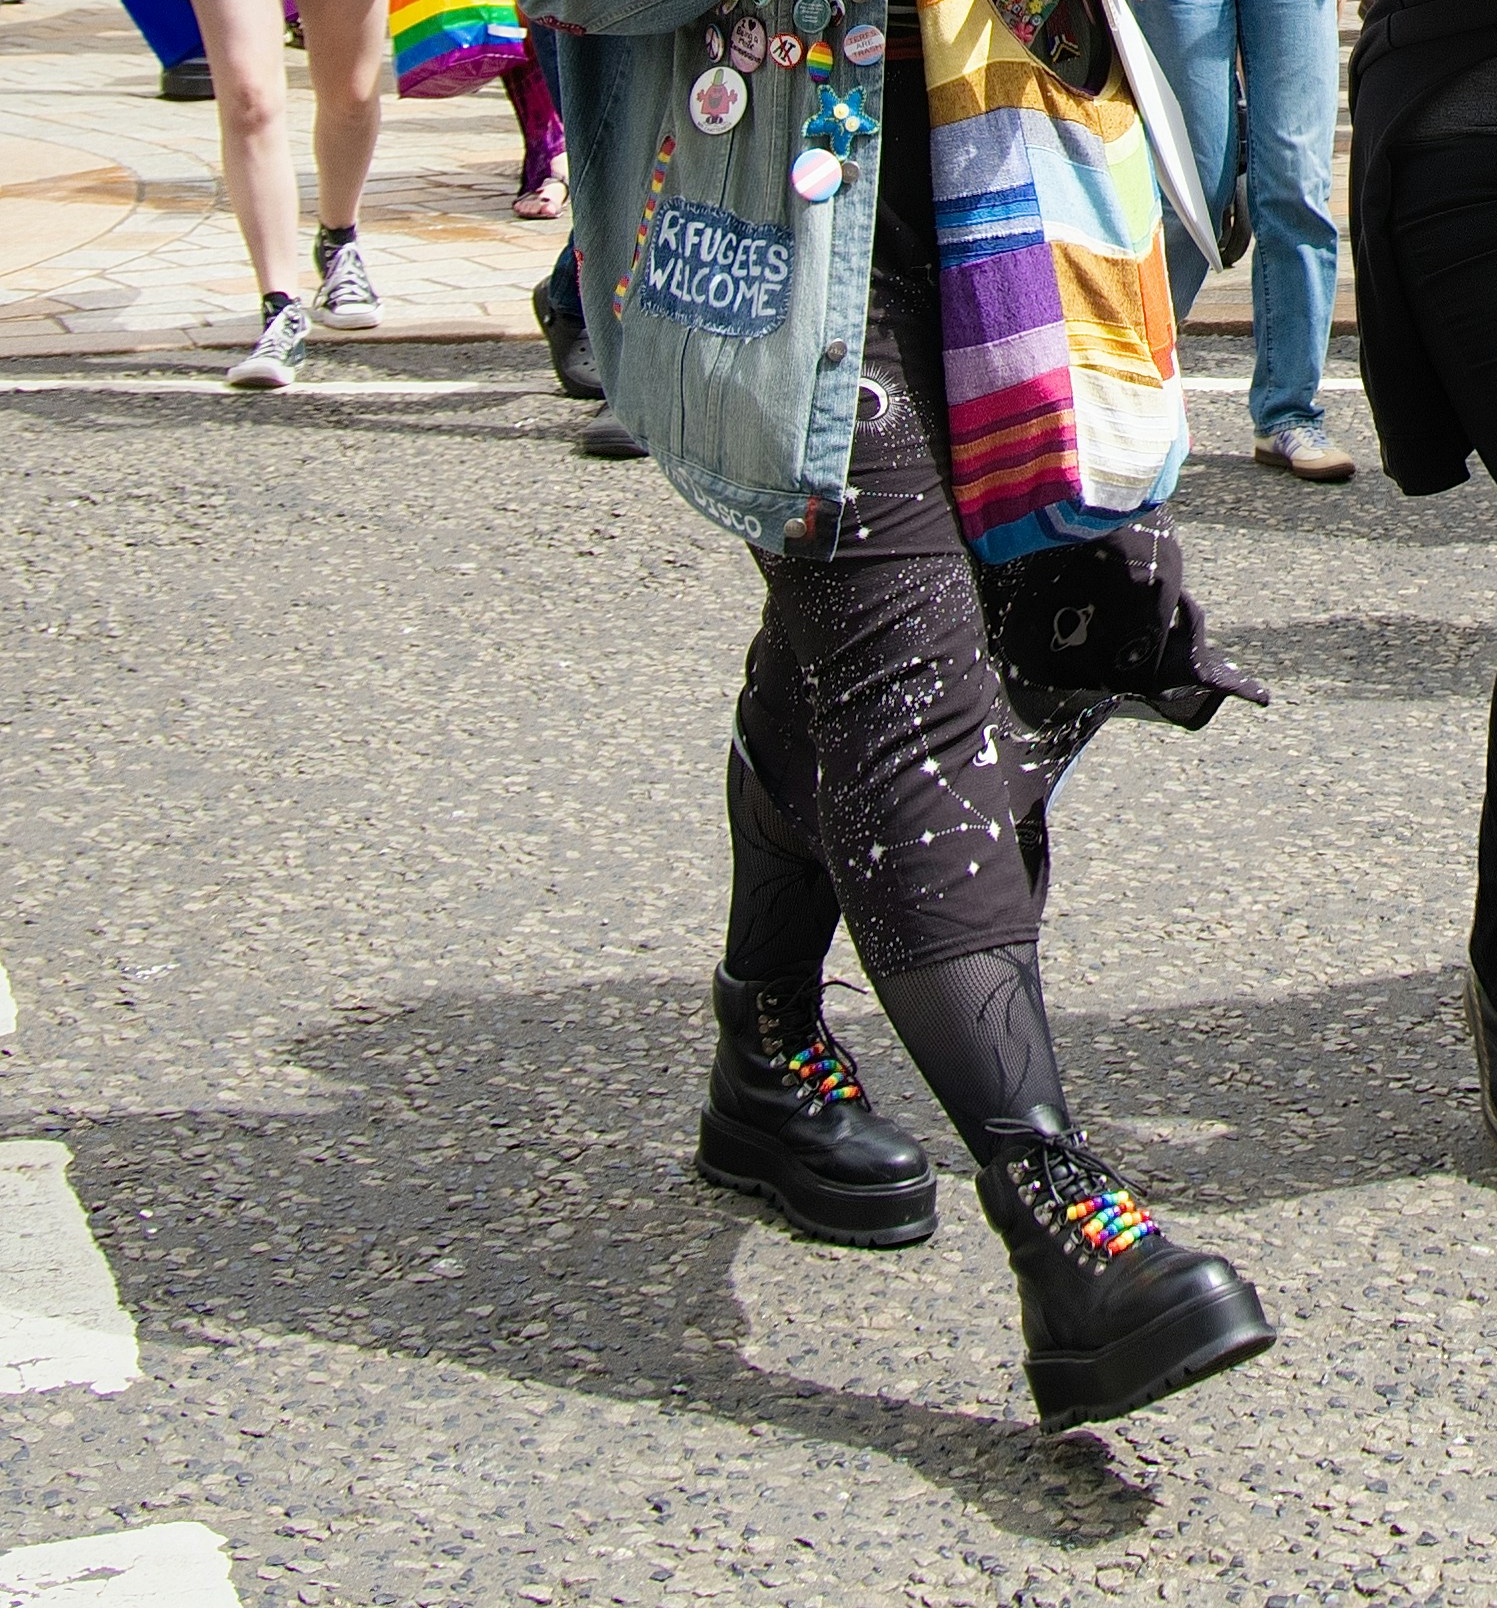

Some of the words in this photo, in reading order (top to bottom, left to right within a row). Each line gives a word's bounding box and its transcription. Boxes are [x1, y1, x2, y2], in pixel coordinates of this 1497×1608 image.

[849, 28, 878, 43] TERFS
[852, 44, 884, 59] TRASH
[855, 39, 873, 49] ARE
[658, 209, 789, 282] RFUGEES
[648, 257, 783, 319] WELCOME
